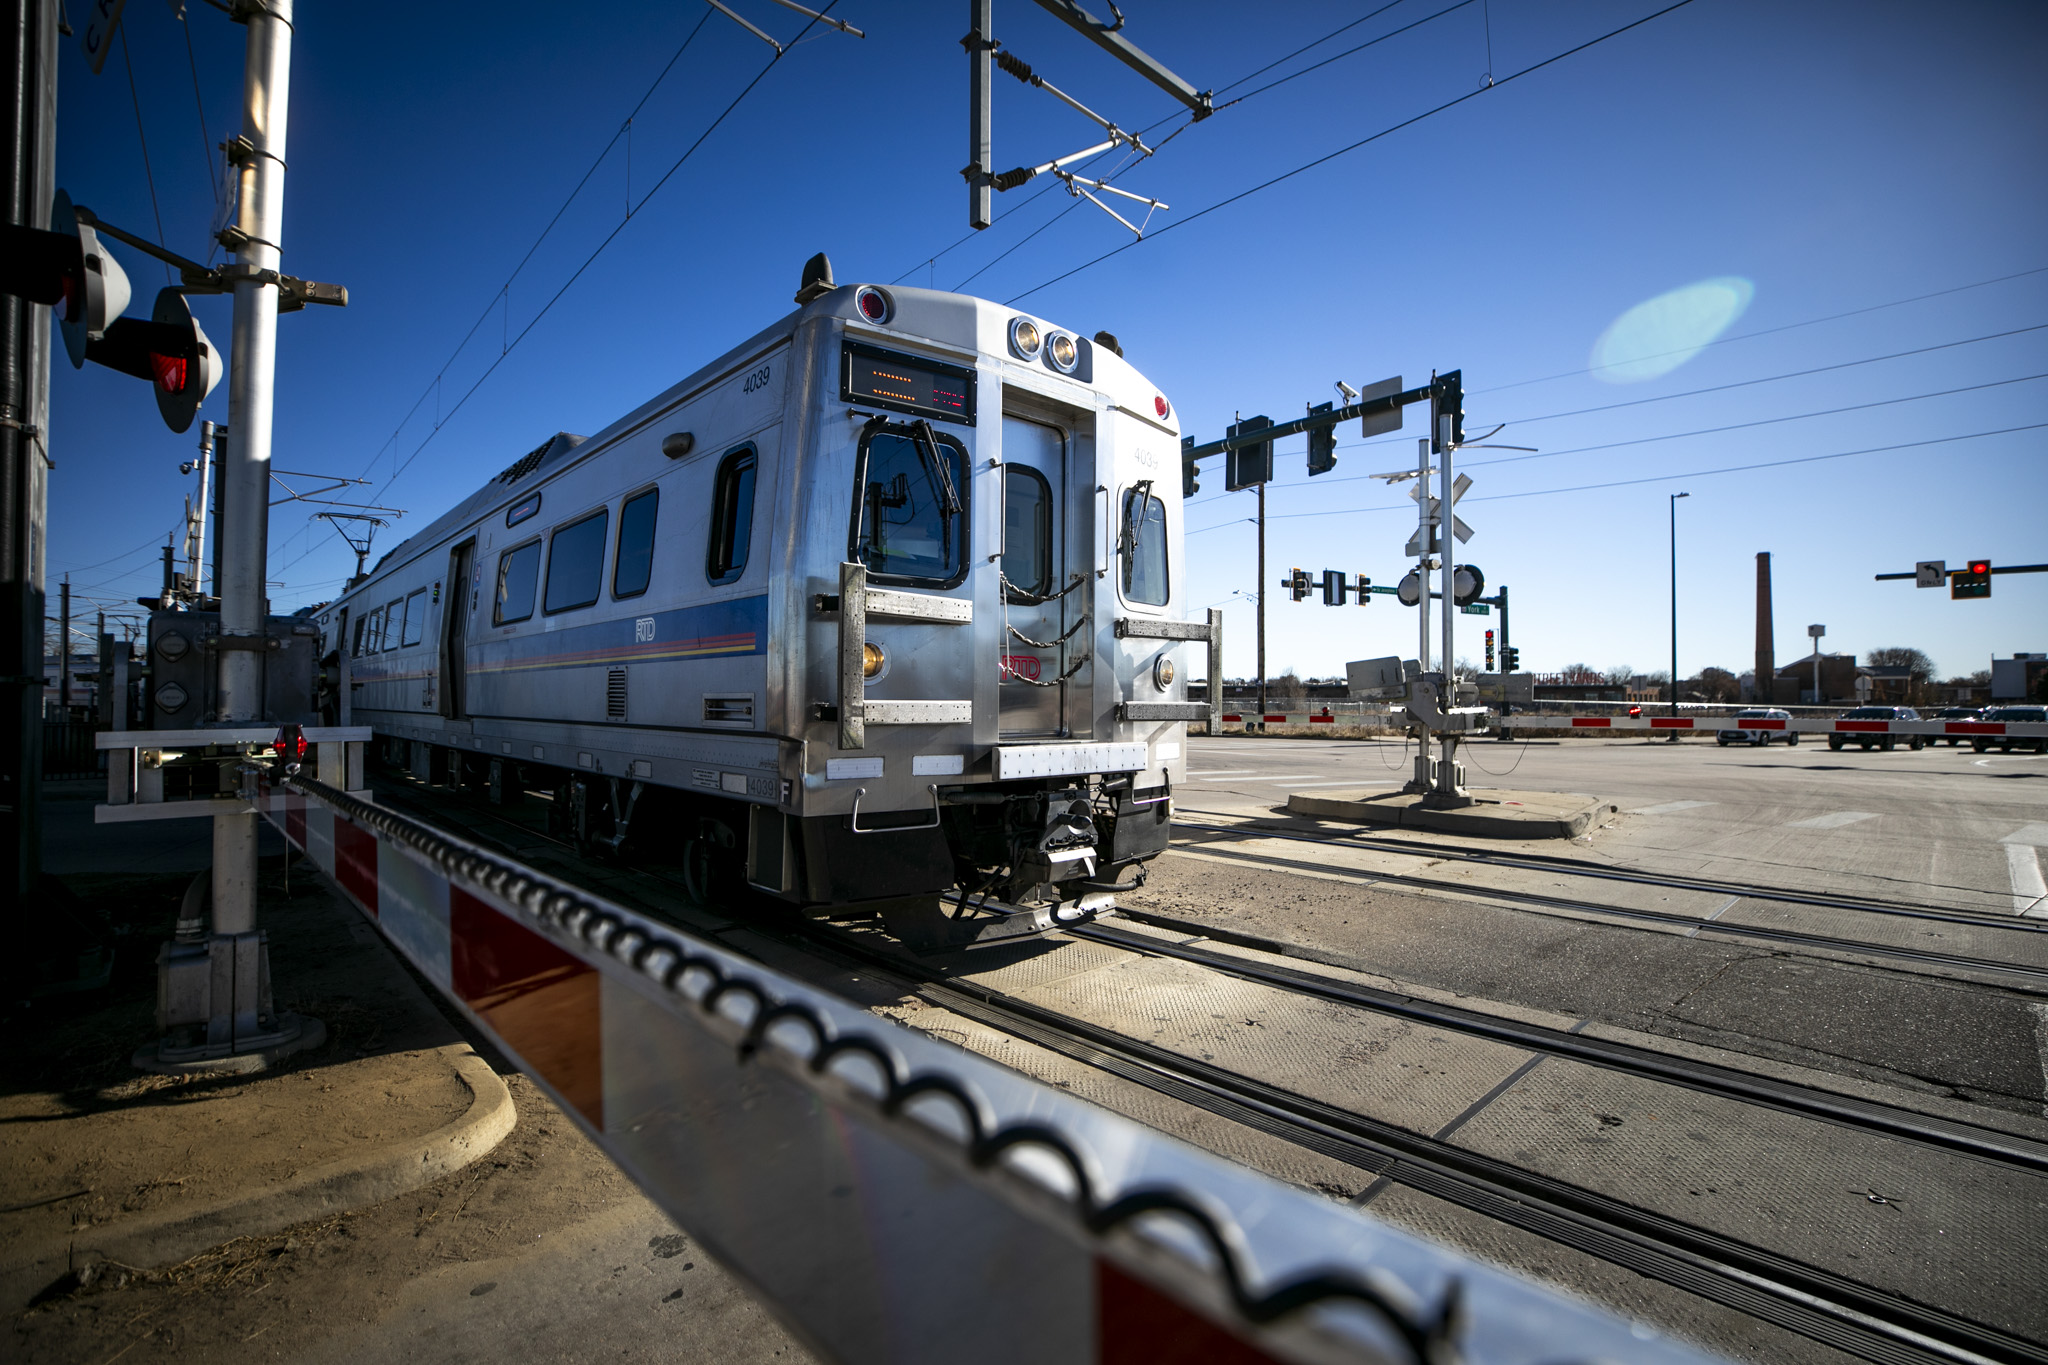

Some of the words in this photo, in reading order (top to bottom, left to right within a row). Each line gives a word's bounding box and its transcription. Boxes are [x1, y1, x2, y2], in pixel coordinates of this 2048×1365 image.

[743, 366, 770, 395] 4039
[1134, 447, 1159, 470] 4039
[1467, 605, 1480, 613] York
[635, 617, 656, 643] RTD
[1002, 655, 1041, 680] RTD
[750, 779, 774, 797] 4039
[781, 781, 790, 803] F
